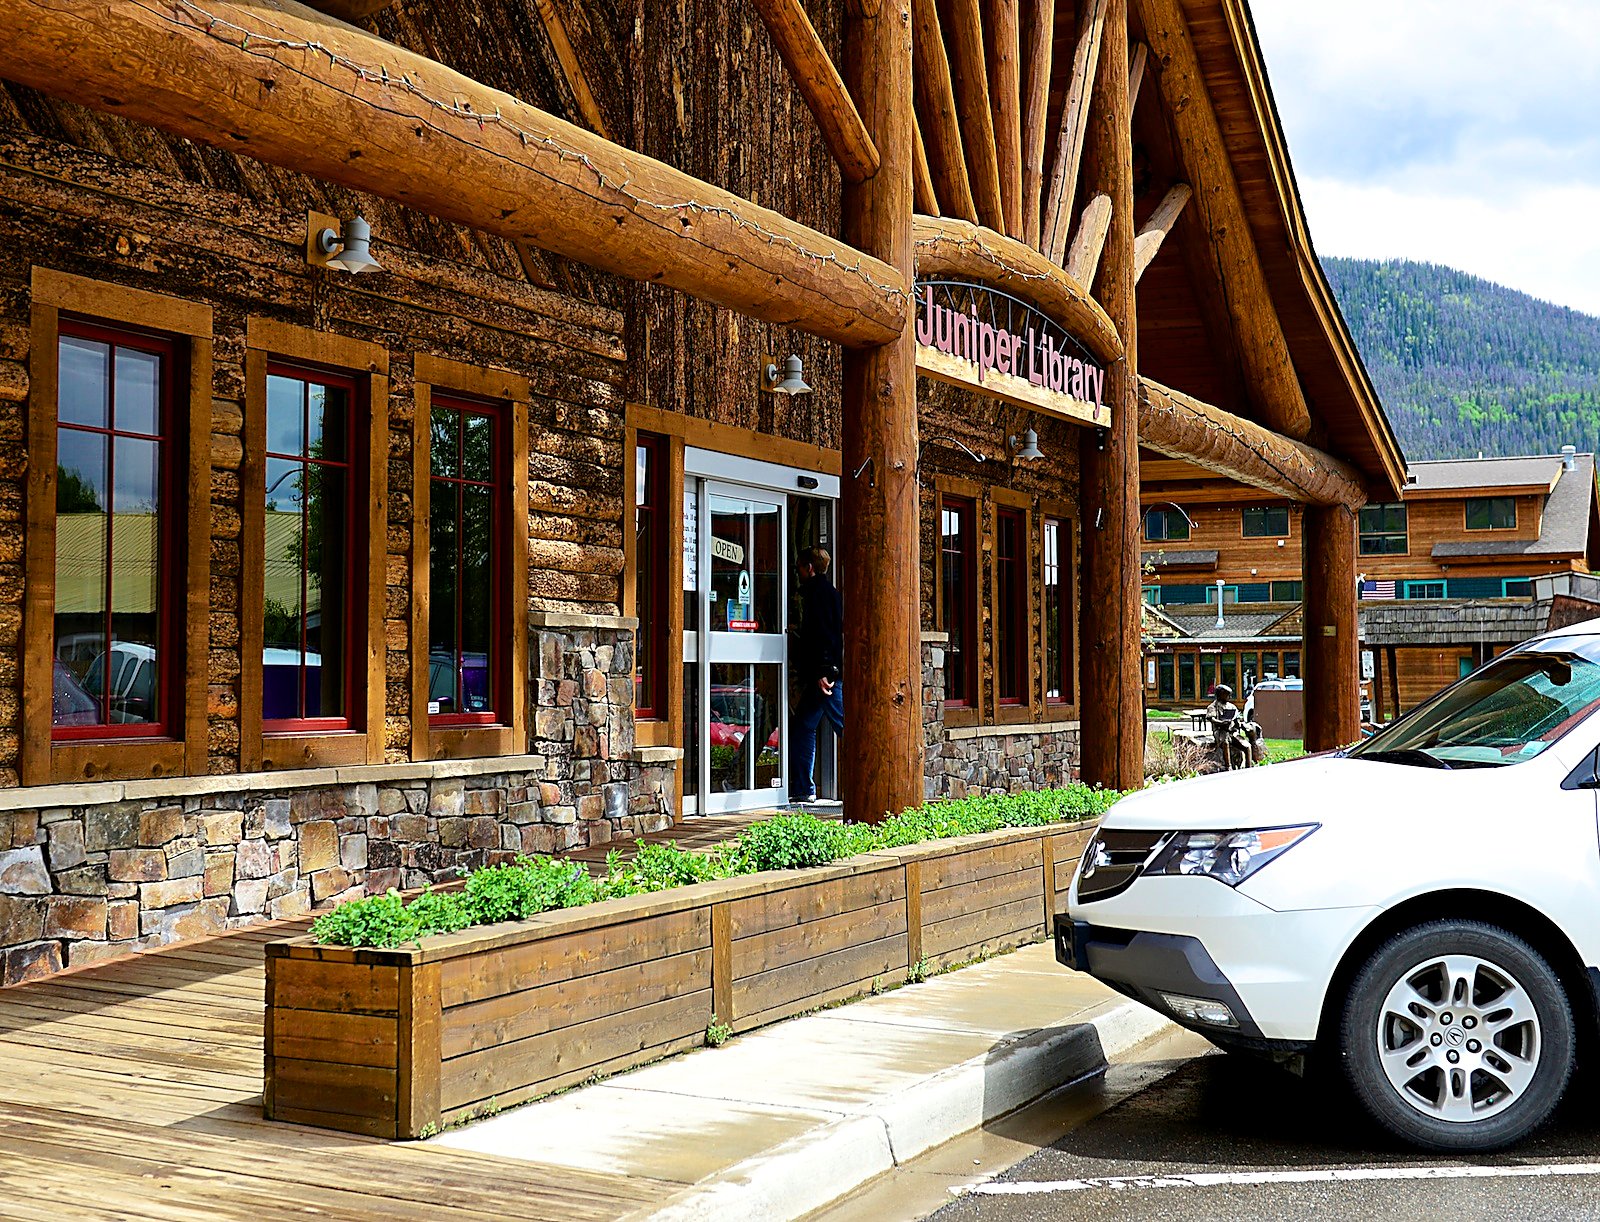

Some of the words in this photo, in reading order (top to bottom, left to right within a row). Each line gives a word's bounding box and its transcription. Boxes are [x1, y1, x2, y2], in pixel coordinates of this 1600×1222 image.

[917, 285, 1021, 381] Juniper
[1029, 327, 1104, 418] Library
[715, 541, 737, 560] OPEN
